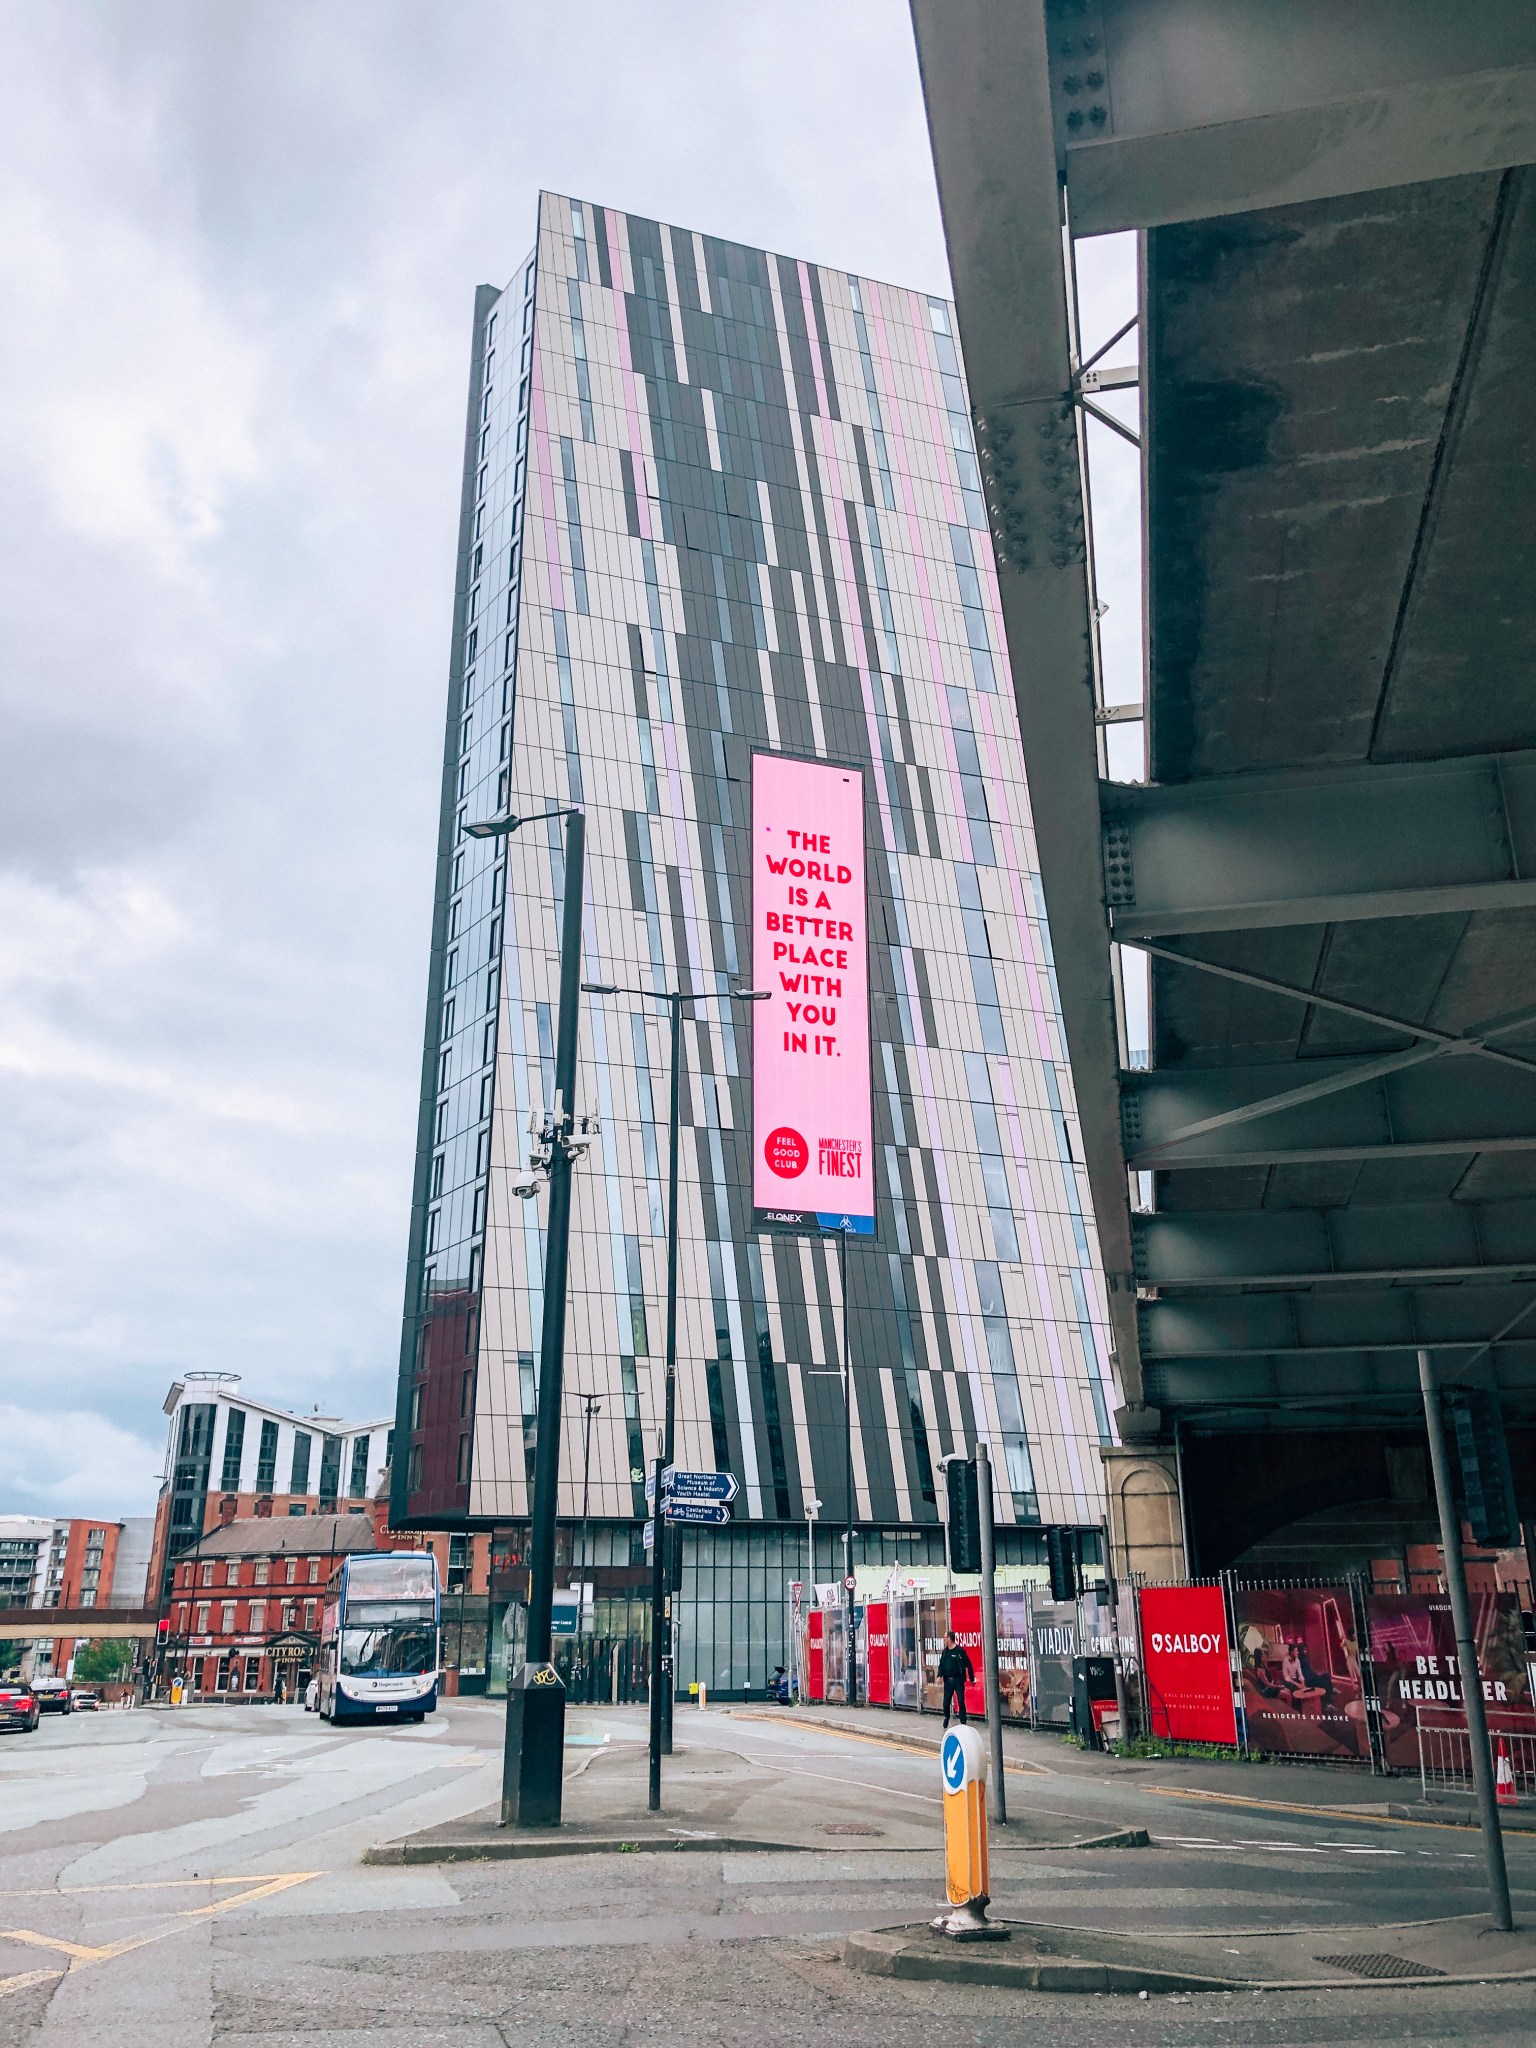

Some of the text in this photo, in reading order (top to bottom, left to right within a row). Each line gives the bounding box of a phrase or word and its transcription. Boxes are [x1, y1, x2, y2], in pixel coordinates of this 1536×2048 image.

[787, 830, 831, 854] THE
[766, 854, 852, 884] WORLD
[788, 886, 832, 910] IS A
[766, 912, 854, 942] BETTER
[774, 941, 848, 970] PLACE
[779, 972, 842, 998] WITH
[786, 1002, 836, 1026] YOU
[783, 1031, 841, 1057] IN IT.
[776, 1136, 796, 1146] FEEL
[818, 1137, 862, 1152] MANCHESTER'S
[773, 1148, 800, 1158] GOOD
[818, 1150, 862, 1178] FINEST
[766, 1212, 802, 1222] ELONEX
[873, 1634, 889, 1647] SALBOY
[960, 1632, 981, 1647] SALBOY
[997, 1638, 1024, 1651] EDEFINING
[1037, 1628, 1076, 1655] VIADUX
[1091, 1636, 1134, 1653] CONNETING
[1164, 1633, 1220, 1654] SALBOY
[266, 1647, 287, 1657] CITY
[998, 1657, 1014, 1670] NTRAL
[1416, 1656, 1439, 1675] BE
[1399, 1680, 1507, 1701] HEADLER
